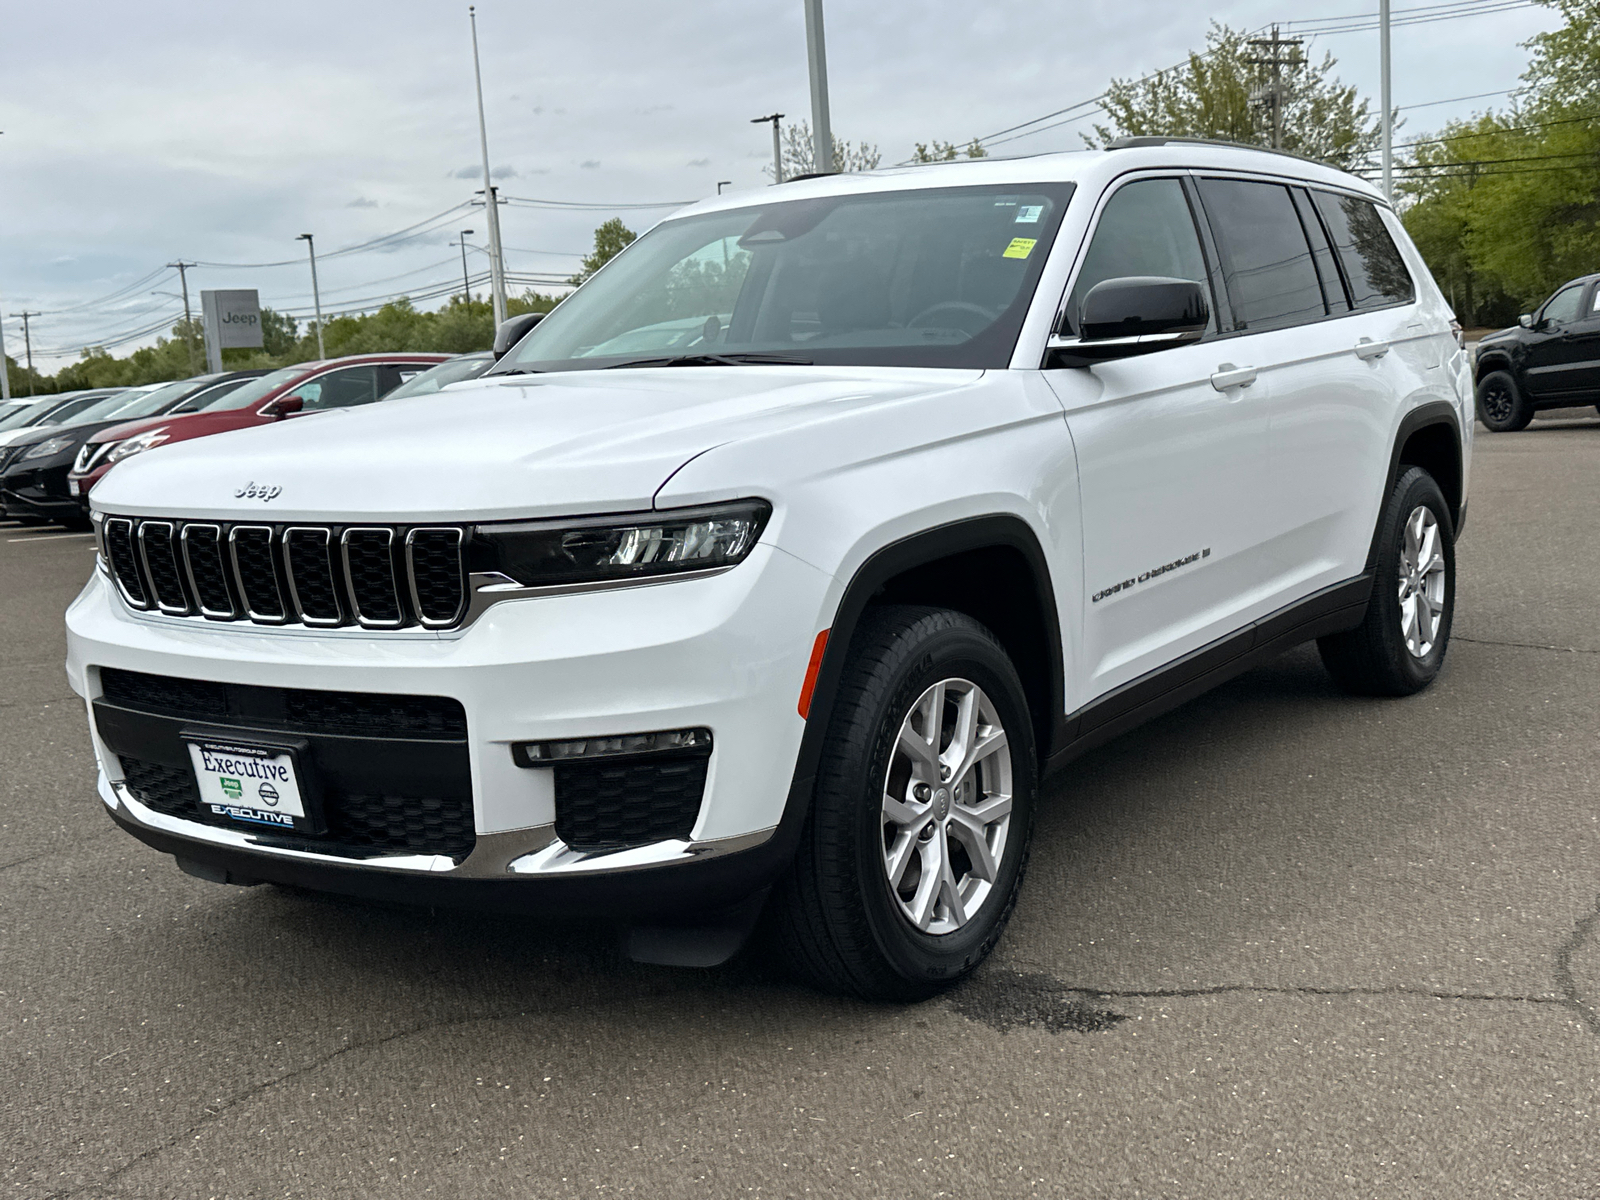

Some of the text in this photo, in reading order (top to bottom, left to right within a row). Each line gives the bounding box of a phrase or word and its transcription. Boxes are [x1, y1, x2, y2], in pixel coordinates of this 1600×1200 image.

[222, 312, 258, 326] Jeep
[234, 481, 283, 502] Jeep
[200, 749, 289, 782] Executive
[211, 804, 294, 825] EXECUTIVE
